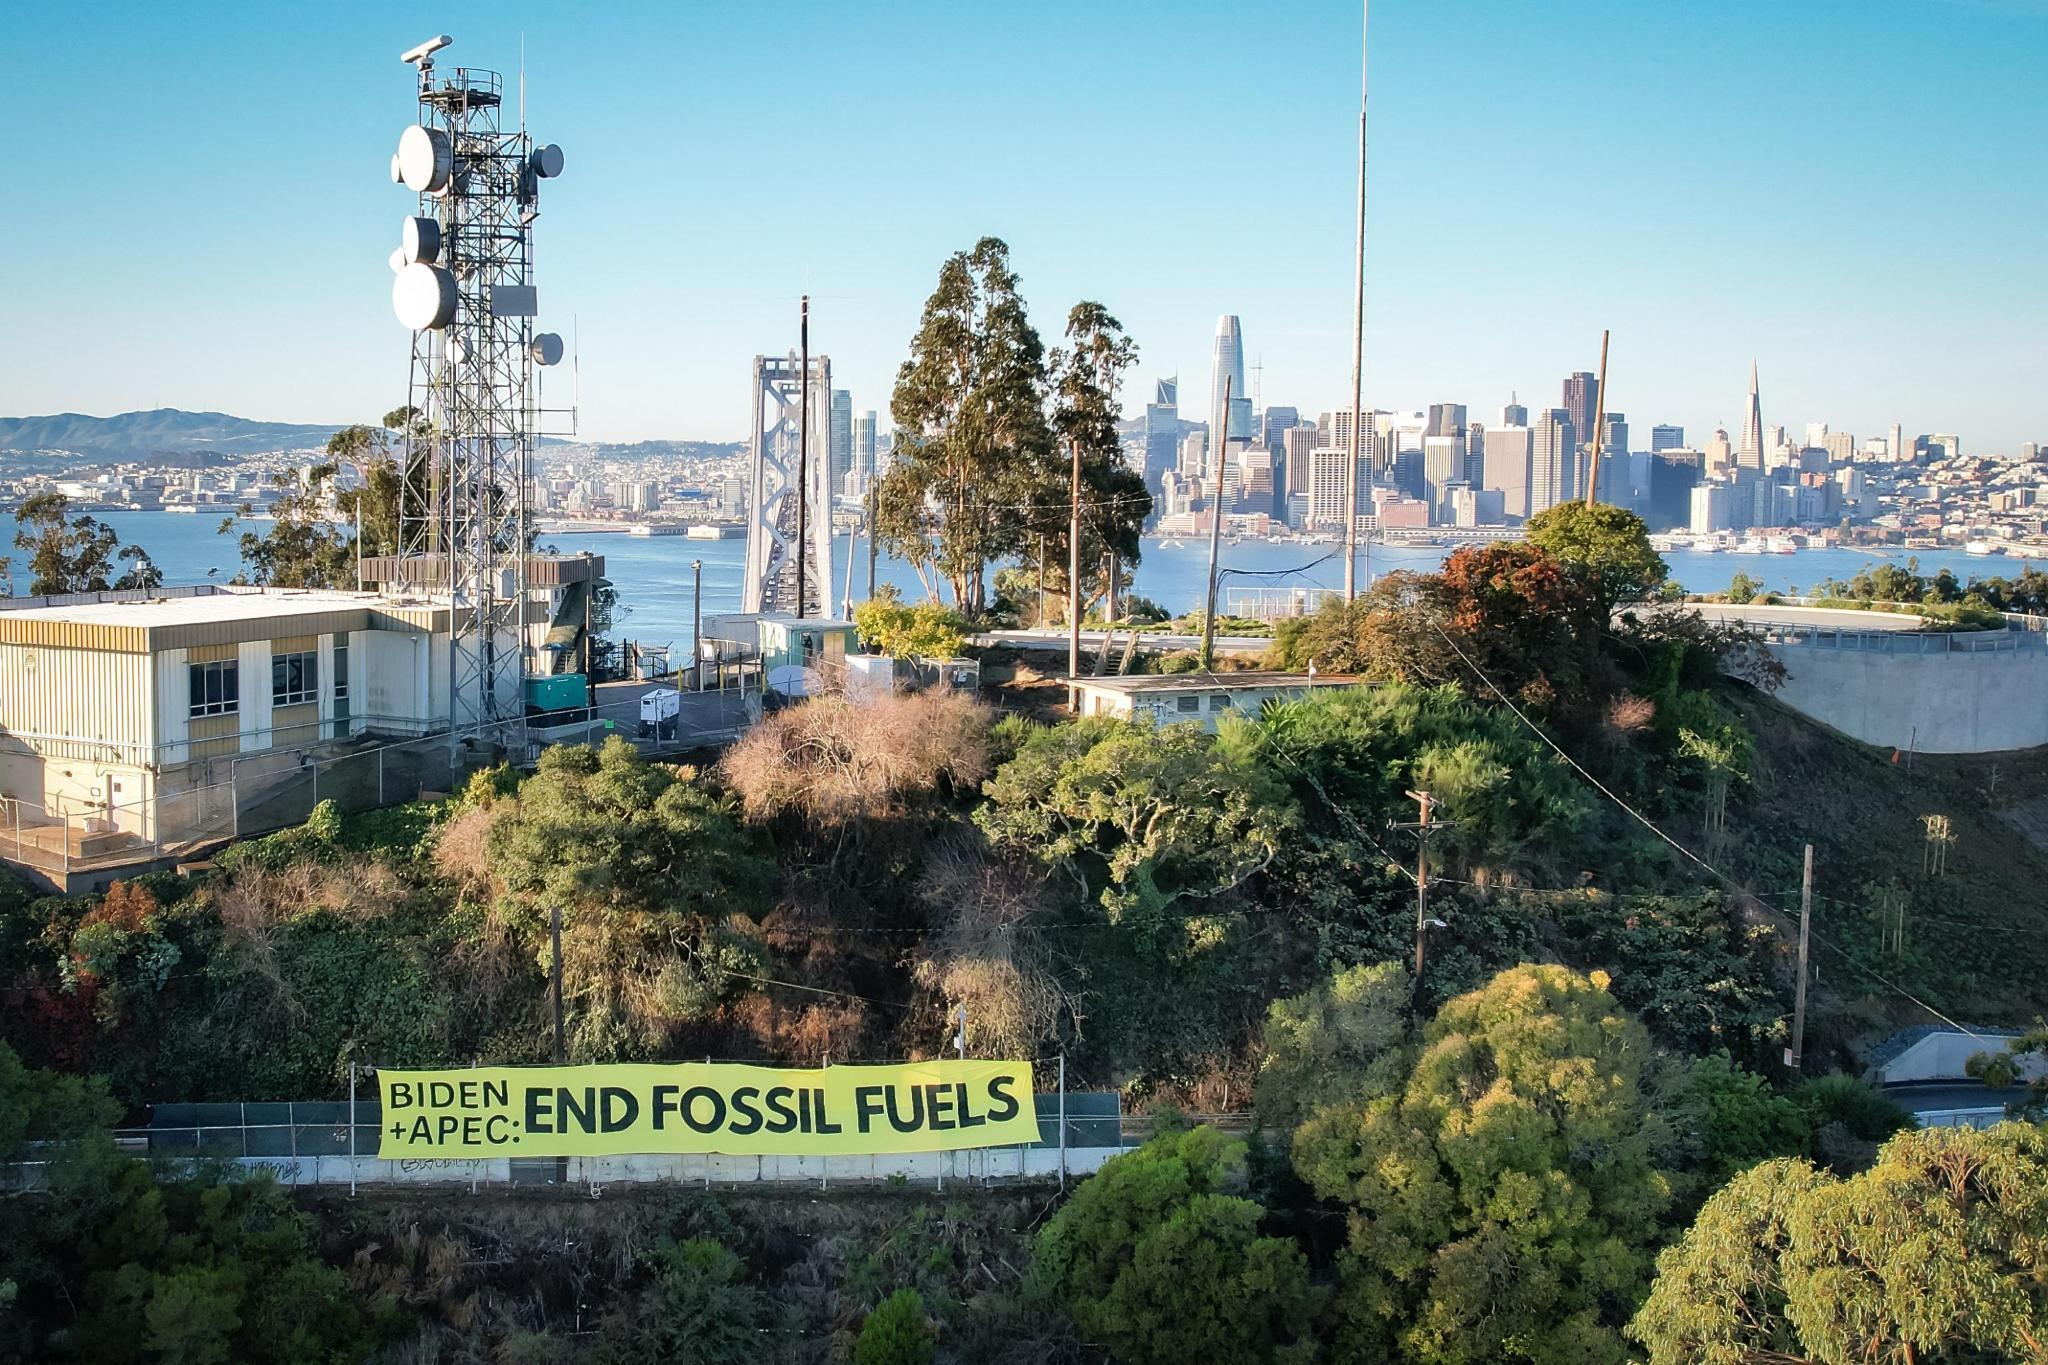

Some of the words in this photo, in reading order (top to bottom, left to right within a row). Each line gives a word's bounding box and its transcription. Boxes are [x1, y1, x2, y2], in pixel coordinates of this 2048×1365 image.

[390, 1080, 509, 1109] BIDEN
[525, 1086, 640, 1134] END
[652, 1085, 842, 1135] FOSSIL
[855, 1076, 1020, 1133] FUELS
